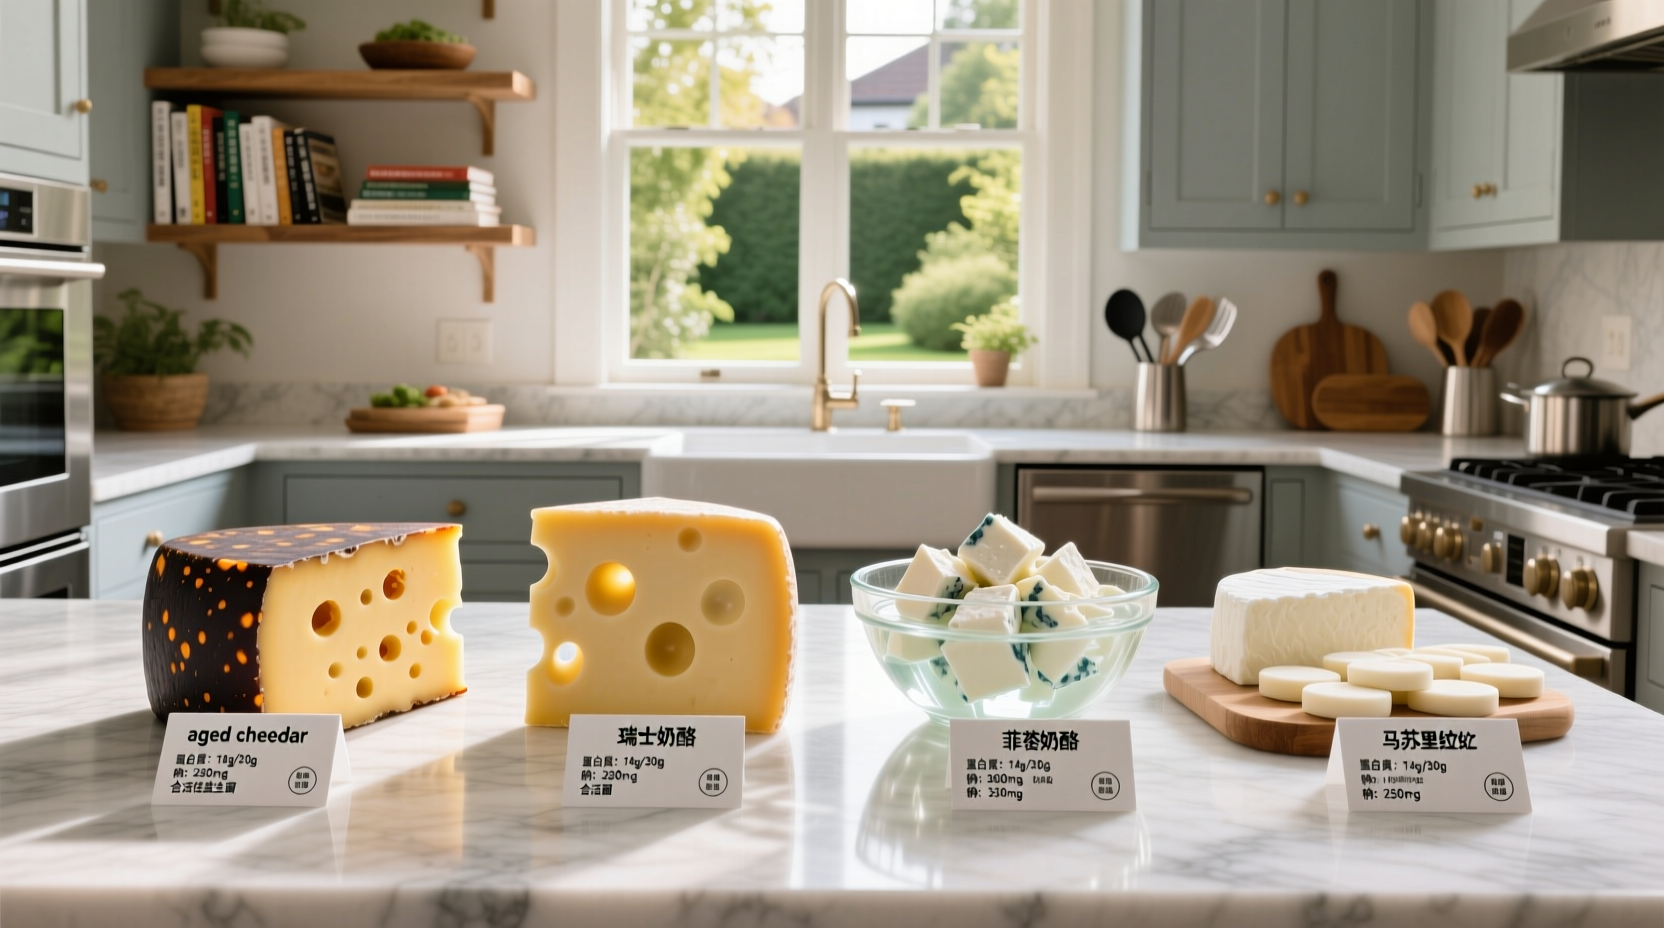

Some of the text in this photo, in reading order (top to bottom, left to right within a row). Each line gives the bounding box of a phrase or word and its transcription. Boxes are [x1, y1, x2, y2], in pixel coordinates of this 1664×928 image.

[187, 726, 309, 746] aged cheedar
[617, 725, 697, 748] 瑞士奶酪
